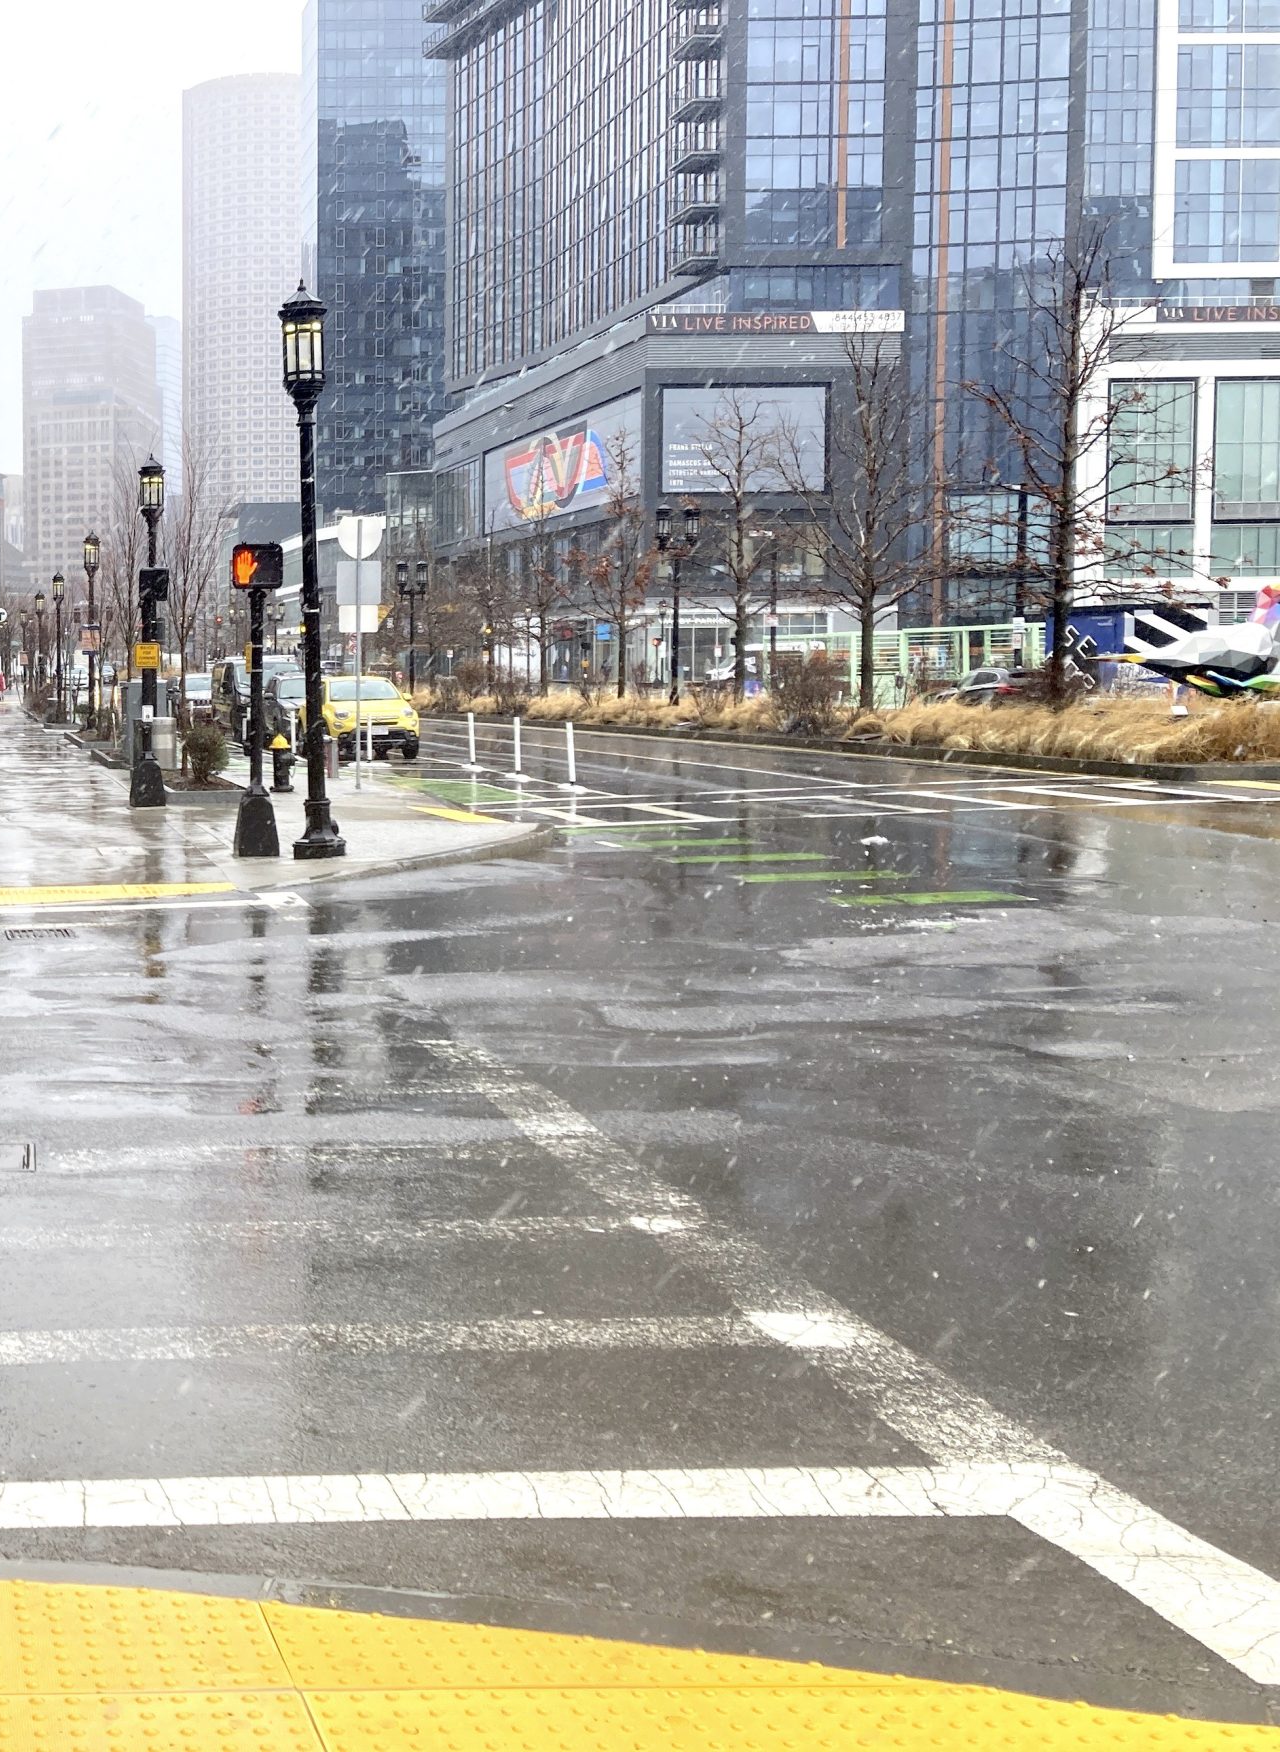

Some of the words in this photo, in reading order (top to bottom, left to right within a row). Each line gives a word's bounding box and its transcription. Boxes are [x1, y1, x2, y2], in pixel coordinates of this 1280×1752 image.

[1193, 307, 1237, 320] LIVE
[651, 315, 678, 328] VIA
[684, 315, 724, 330] LIVE
[733, 315, 811, 330] INSPIRED
